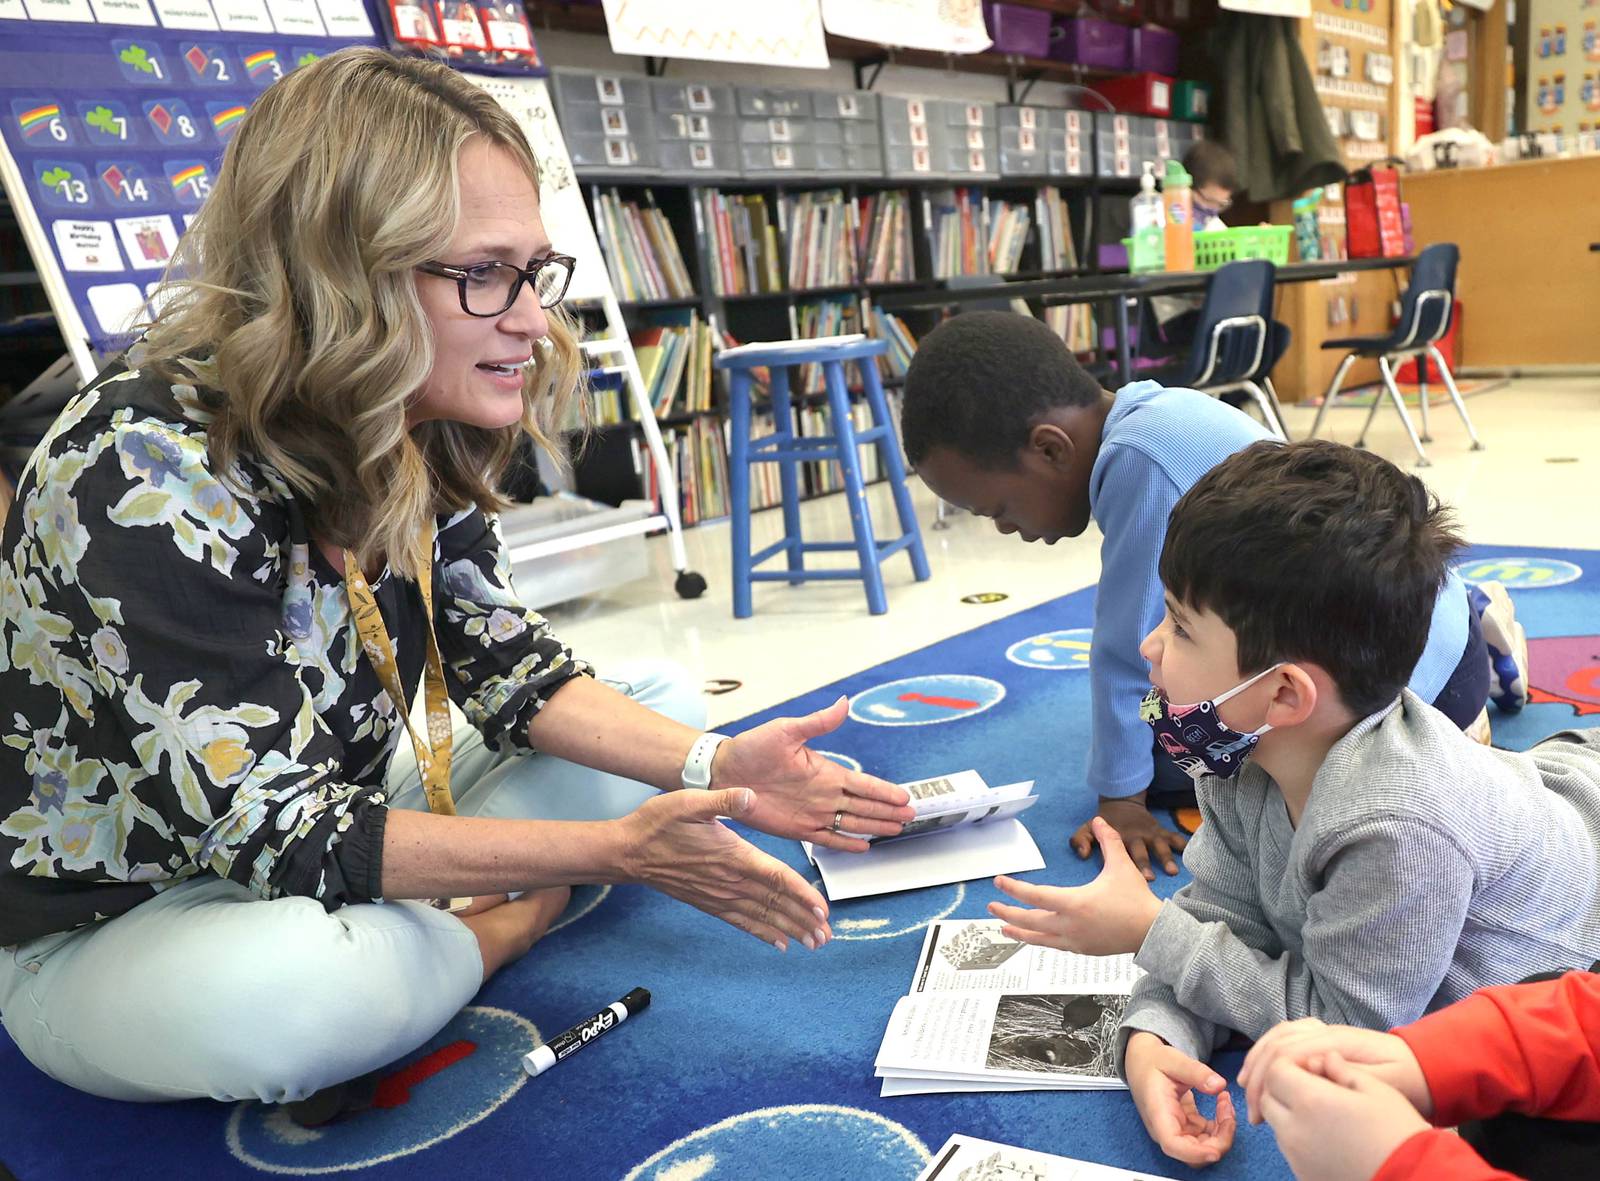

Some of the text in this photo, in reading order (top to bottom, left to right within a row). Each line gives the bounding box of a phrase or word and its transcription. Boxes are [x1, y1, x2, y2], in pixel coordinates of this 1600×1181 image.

[148, 56, 284, 81] 1 2 3
[50, 115, 196, 142] 6 7 8
[59, 176, 212, 204] 13 14 15
[581, 1011, 614, 1042] EXPO
